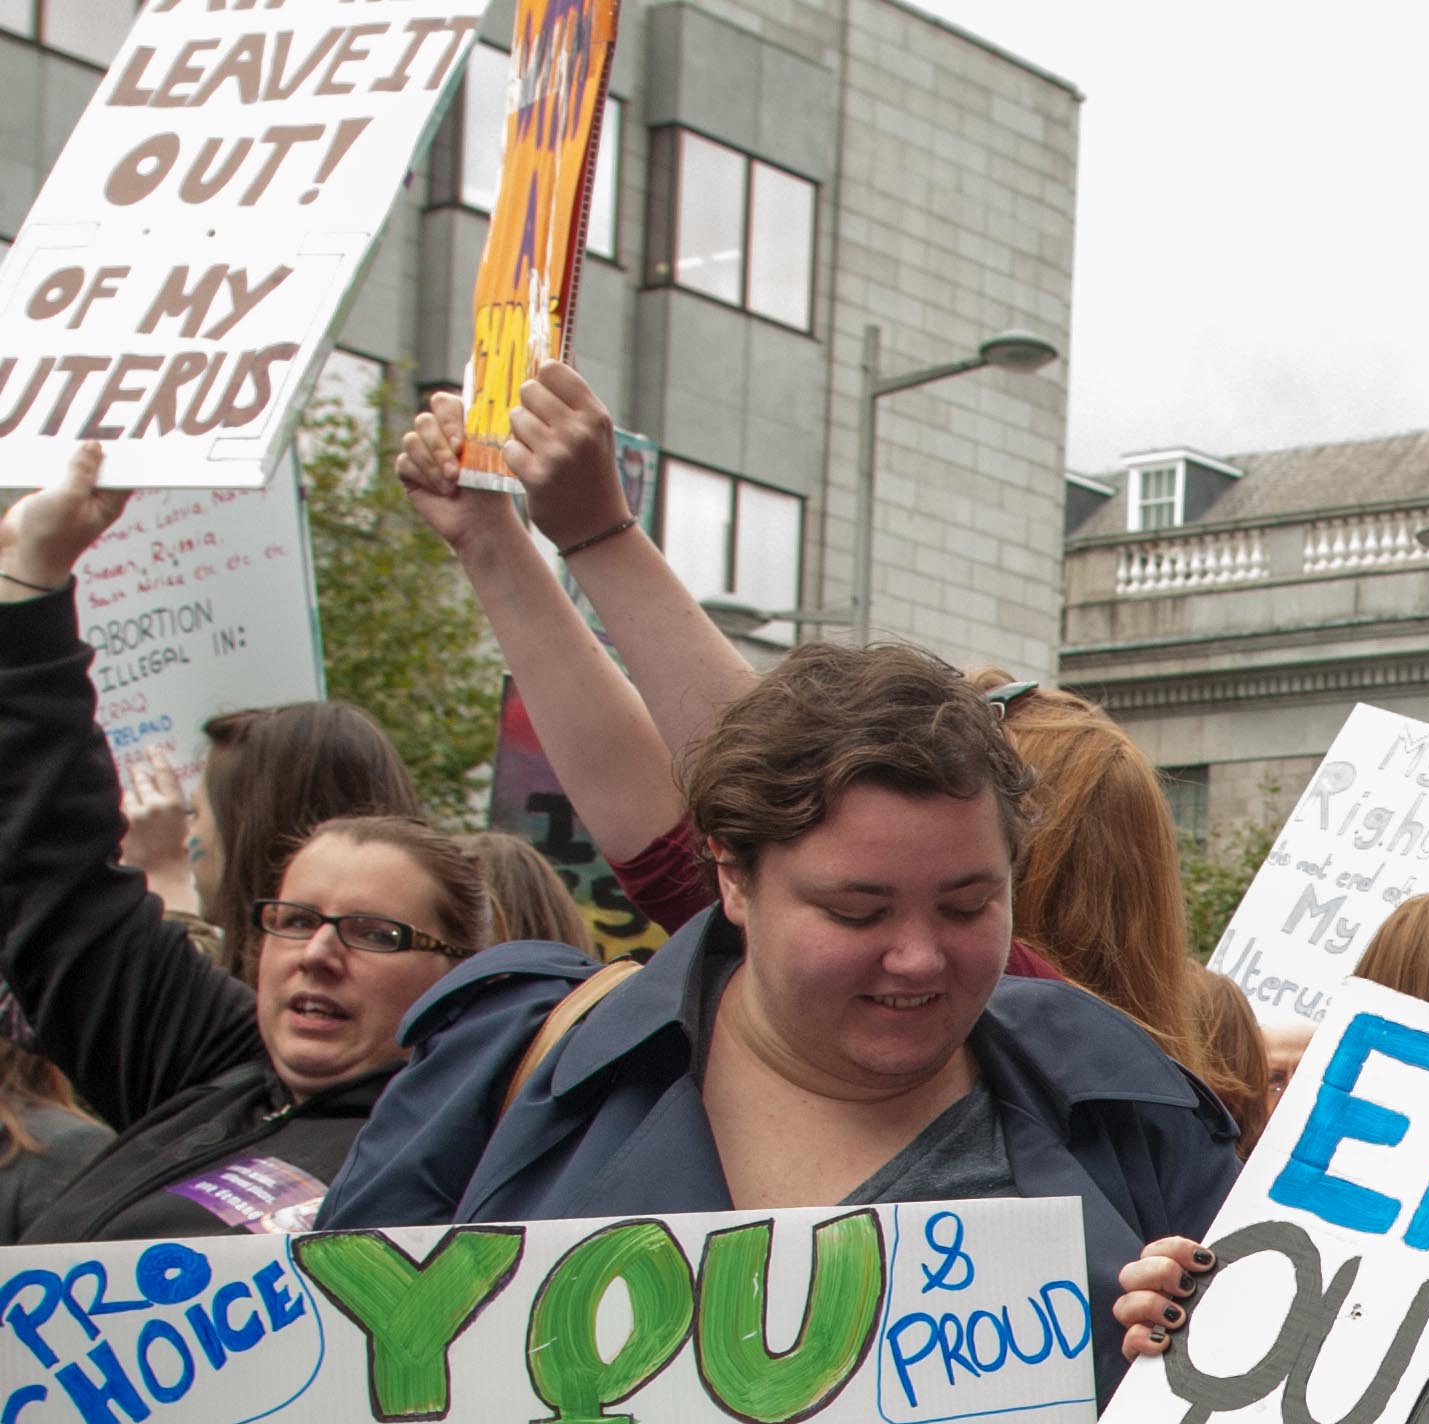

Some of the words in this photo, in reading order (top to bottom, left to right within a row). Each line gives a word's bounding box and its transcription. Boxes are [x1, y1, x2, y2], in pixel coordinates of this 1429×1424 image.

[105, 22, 391, 108] LEAVE
[368, 15, 481, 93] IT
[103, 116, 375, 206] OUT!
[26, 265, 132, 330] OF
[135, 263, 294, 341] MY
[86, 597, 214, 658] ABORTION
[98, 649, 191, 693] ILLEGAL
[1280, 882, 1361, 955] My
[886, 1279, 1093, 1407] PROUD
